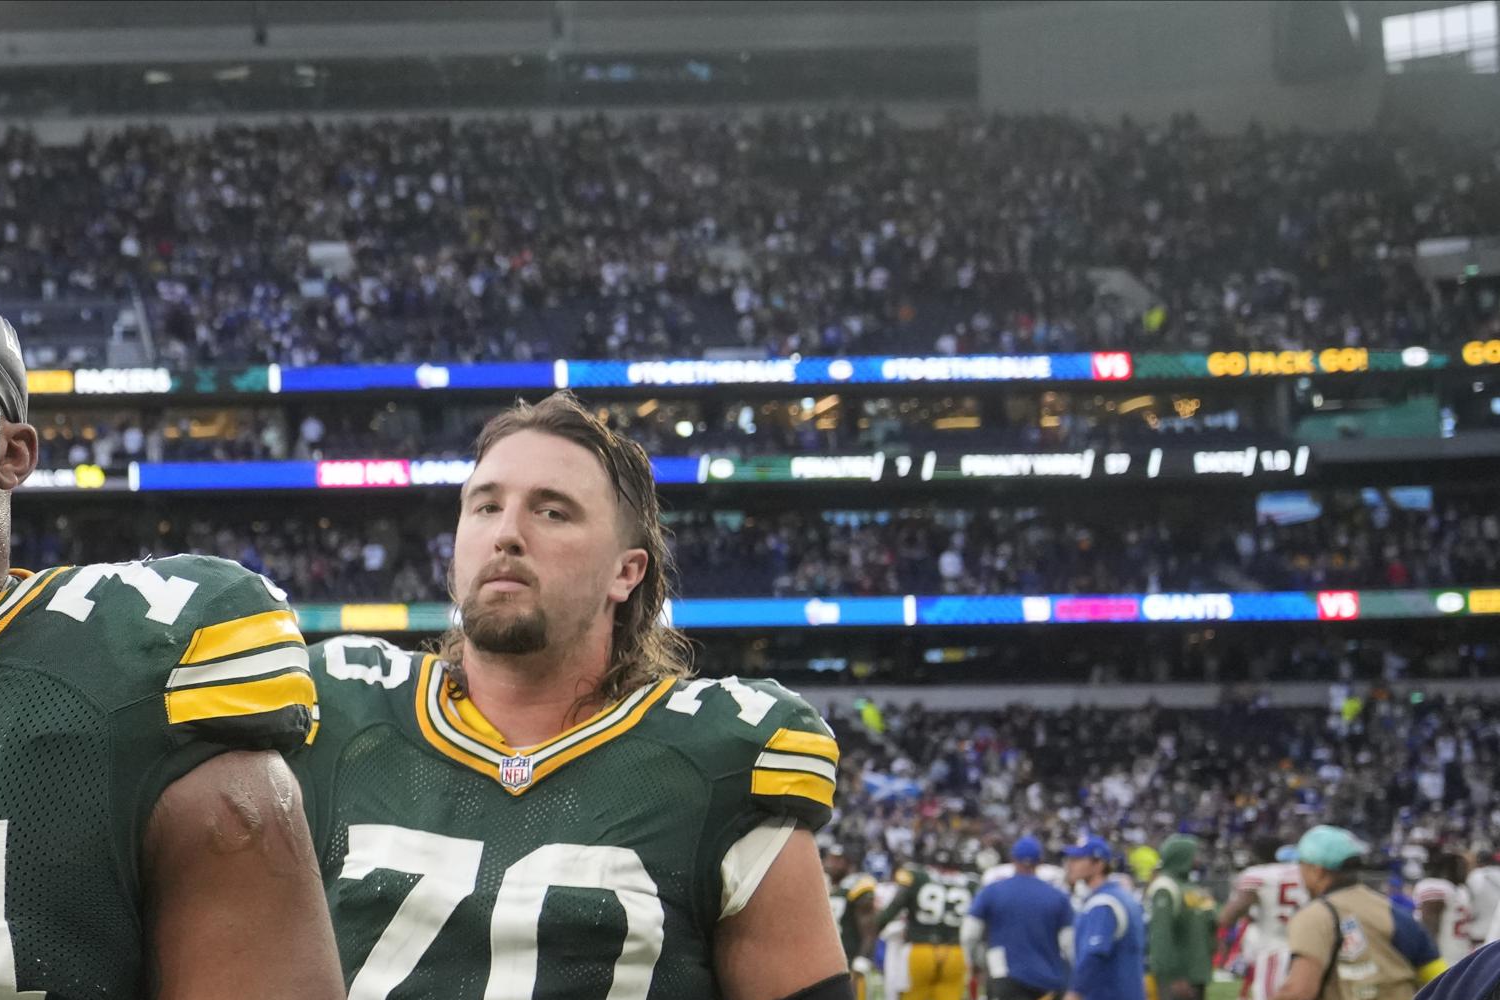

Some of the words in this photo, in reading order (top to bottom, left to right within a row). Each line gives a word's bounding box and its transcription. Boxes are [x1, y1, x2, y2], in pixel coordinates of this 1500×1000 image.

[1095, 353, 1131, 379] VS
[1207, 351, 1248, 377] GO
[1249, 350, 1316, 375] PACK
[1319, 347, 1369, 373] GO!
[1142, 593, 1234, 620] GIANTS
[1319, 591, 1357, 618] VS
[504, 768, 528, 785] NFL
[915, 882, 974, 928] 93
